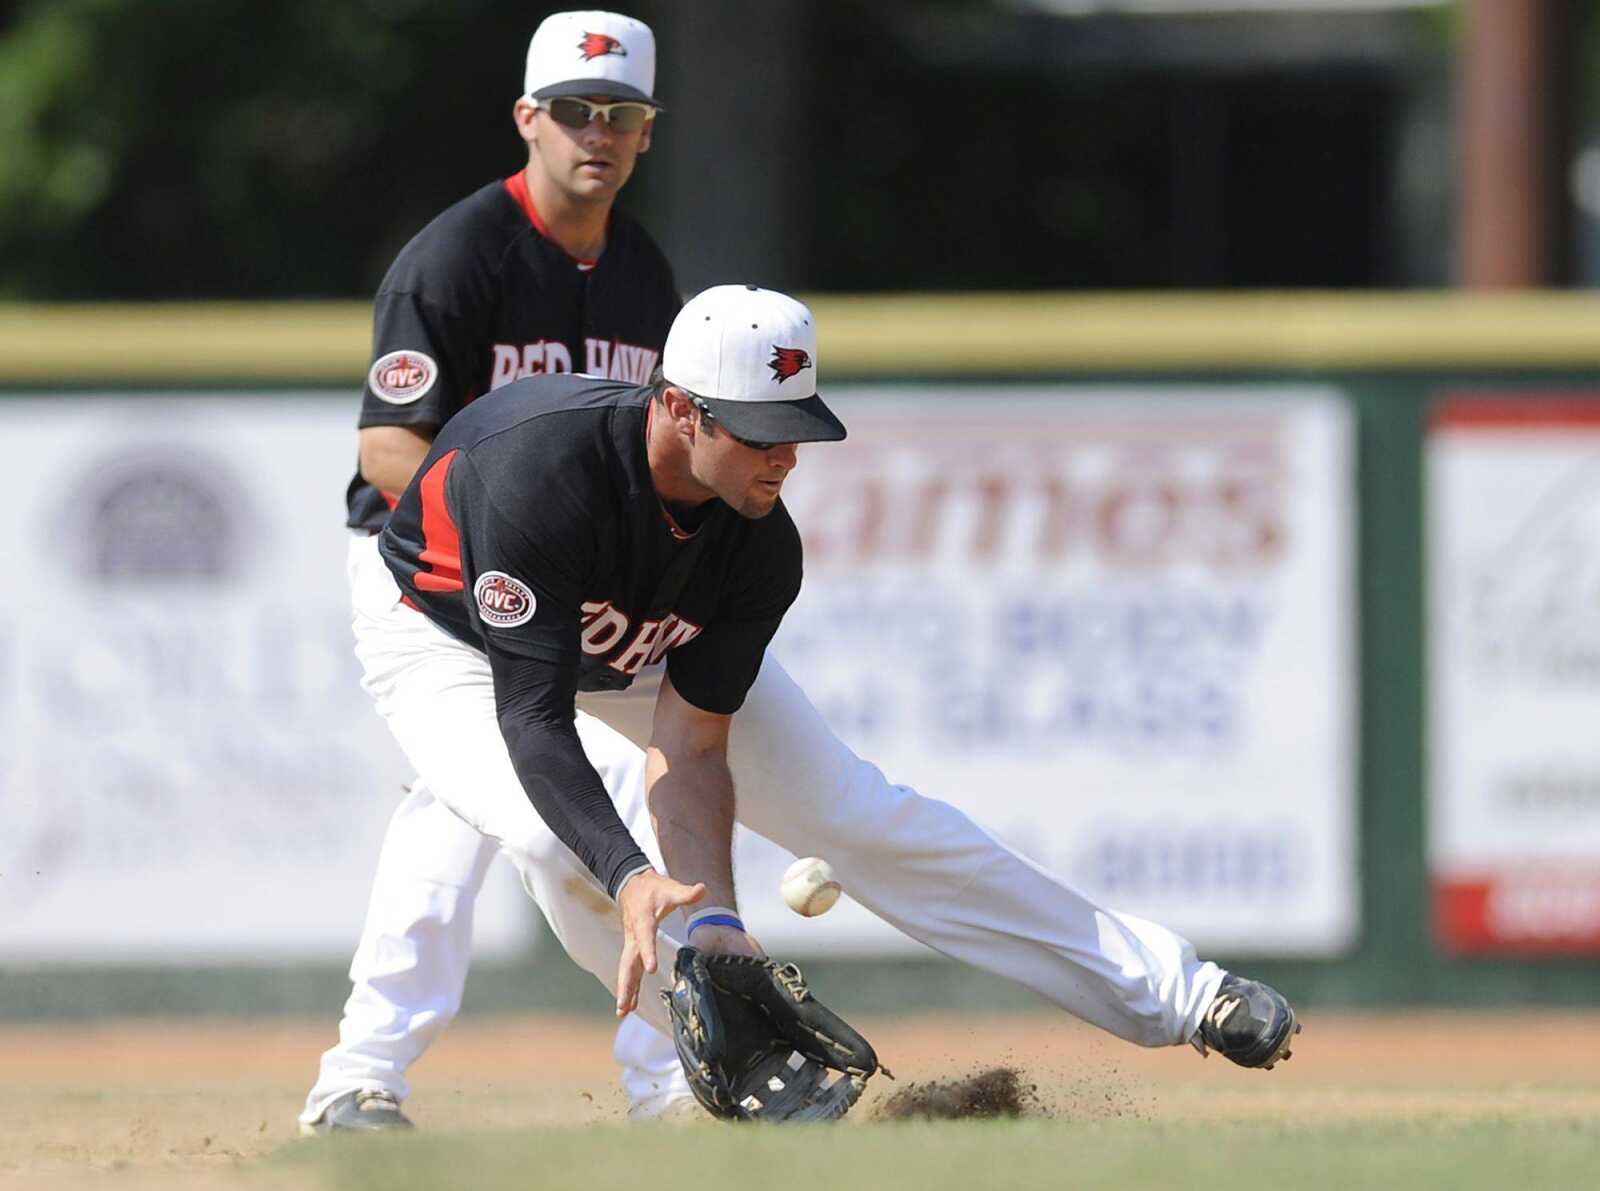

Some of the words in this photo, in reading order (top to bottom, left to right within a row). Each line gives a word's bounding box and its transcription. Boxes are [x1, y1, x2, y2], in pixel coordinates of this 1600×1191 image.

[584, 336, 659, 388] HAW
[385, 367, 420, 388] OVC
[484, 588, 517, 611] OVC
